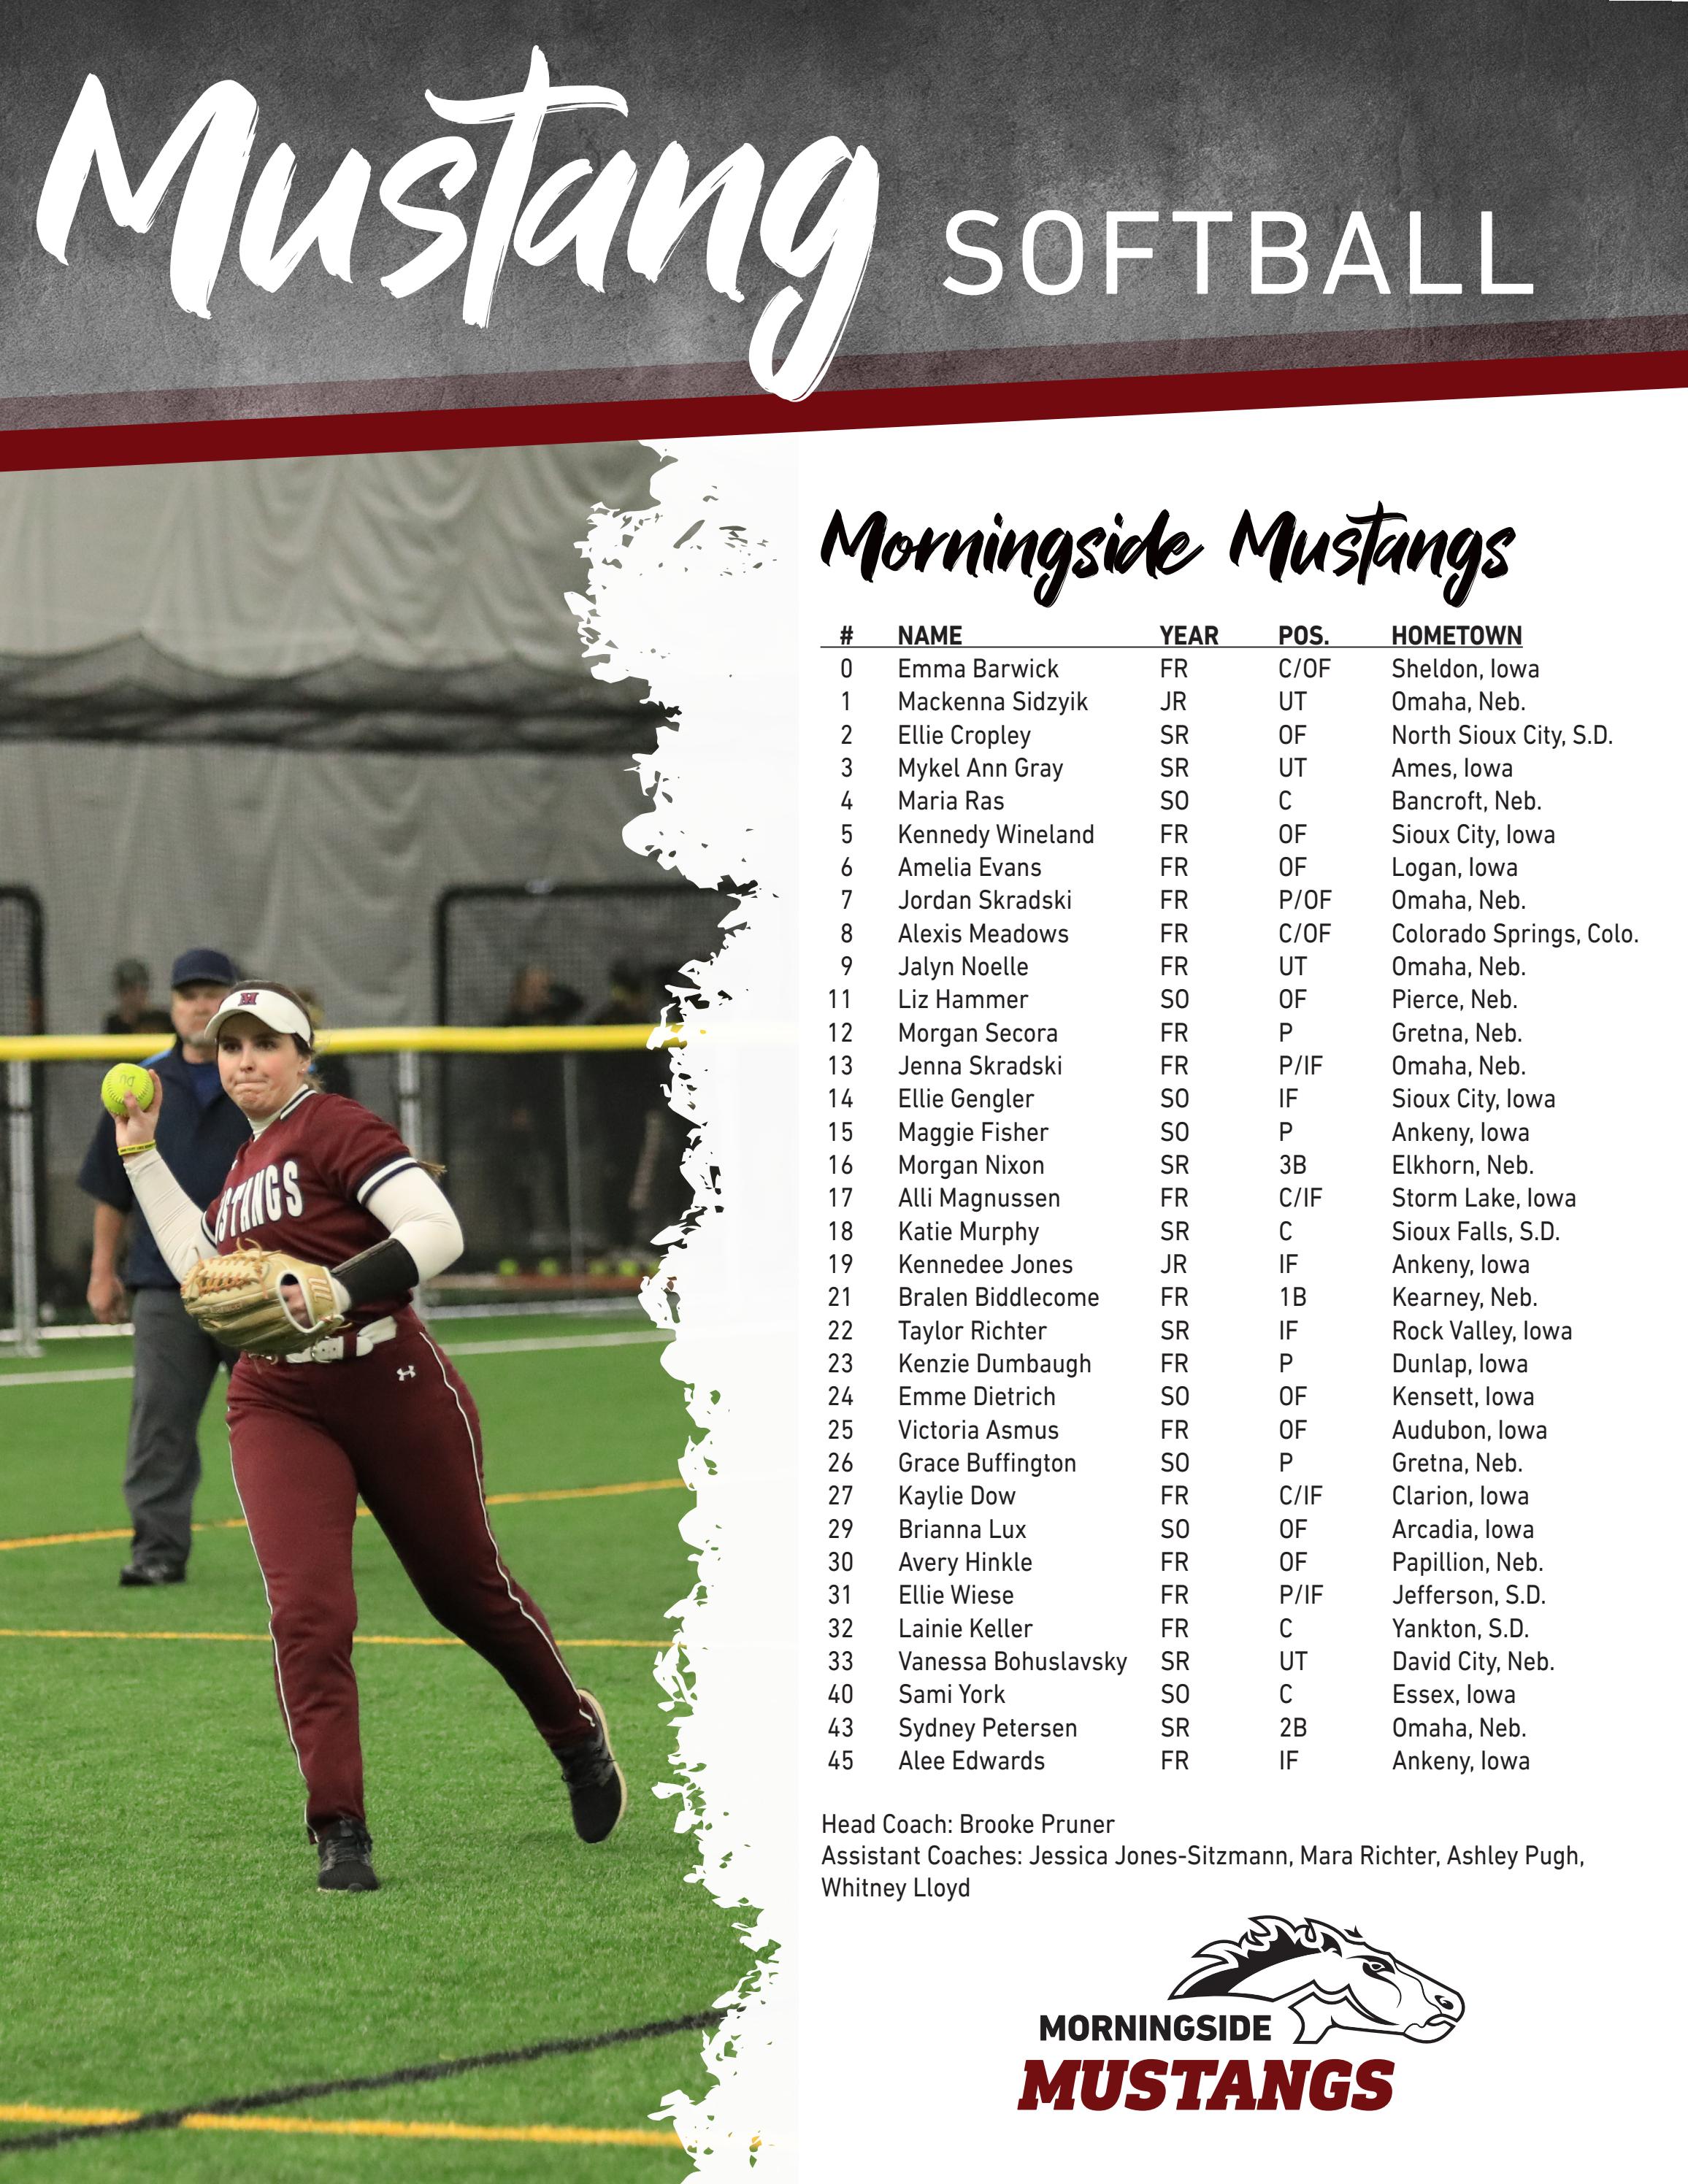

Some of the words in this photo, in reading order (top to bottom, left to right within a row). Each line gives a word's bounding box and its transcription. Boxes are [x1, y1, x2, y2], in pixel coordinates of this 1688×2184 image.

[37, 45, 879, 401] Mustang
[943, 210, 1533, 295] SOFTBALL
[821, 509, 1204, 608] Morningside
[1229, 501, 1516, 608] Mustangs
[840, 626, 853, 645] #
[899, 626, 962, 645] NAME
[1160, 626, 1219, 645] YEAR
[1280, 626, 1329, 645] POS.
[1393, 626, 1522, 645] HOMETOWN
[842, 658, 852, 678] 0
[899, 658, 964, 678] Emma
[974, 658, 1059, 678] Barwick
[1162, 658, 1187, 677] FR
[1280, 658, 1331, 678] C/OF
[1392, 658, 1483, 680] Sheldon,
[1492, 658, 1538, 678] Iowa
[843, 691, 848, 710] 1
[899, 691, 1004, 711] Mackenna
[1013, 691, 1088, 715] Sidzyik
[1160, 691, 1186, 711] JR
[1280, 691, 1307, 711] UT
[1393, 691, 1471, 713] Omaha,
[1480, 691, 1524, 711] Neb.
[842, 758, 852, 777] 3
[899, 758, 959, 782] Mykel
[967, 758, 1006, 777] Ann
[1016, 758, 1063, 782] Gray
[1161, 758, 1189, 777] SR
[1280, 758, 1307, 777] UT
[1392, 758, 1457, 780] Ames,
[1465, 758, 1512, 777] Iowa
[843, 824, 852, 844] 5
[899, 824, 989, 848] Kennedy
[997, 824, 1093, 844] Wineland
[1162, 824, 1188, 843] FR
[1280, 824, 1307, 844] OF
[1392, 824, 1449, 844] Sioux
[1458, 824, 1499, 848] City,
[1508, 824, 1554, 844] Iowa
[842, 923, 852, 943] 8
[898, 923, 962, 943] Alexis
[970, 923, 1068, 943] Meadows
[1162, 923, 1188, 942] FR
[1280, 923, 1331, 943] C/OF
[1393, 923, 1486, 943] Colorado
[1494, 923, 1580, 947] Springs,
[1589, 923, 1638, 943] Colo.
[842, 956, 852, 975] 9
[899, 956, 953, 980] Jalyn
[963, 956, 1028, 976] Noelle
[1162, 956, 1188, 975] FR
[1281, 956, 1307, 976] UT
[1393, 956, 1471, 978] Omaha,
[1480, 956, 1524, 976] Neb.
[829, 1023, 852, 1042] 12
[899, 1023, 977, 1047] Morgan
[986, 1023, 1057, 1042] Secora
[1162, 1023, 1188, 1042] FR
[1281, 1023, 1292, 1042] P
[1393, 1023, 1468, 1045] Gretna,
[1477, 1023, 1522, 1042] Neb.
[829, 1088, 853, 1107] 14
[899, 1088, 943, 1108] Ellie
[952, 1088, 1035, 1112] Gengler
[1161, 1088, 1189, 1108] SO
[1281, 1088, 1298, 1107] IF
[1393, 1088, 1450, 1108] Sioux
[1458, 1088, 1499, 1112] City,
[1508, 1088, 1554, 1108] Iowa
[829, 1188, 852, 1207] 17
[899, 1188, 931, 1207] Alli
[940, 1188, 1059, 1212] Magnussen
[1162, 1188, 1188, 1207] FR
[1280, 1188, 1322, 1207] C/IF
[1393, 1188, 1457, 1207] Storm
[1466, 1188, 1519, 1210] Lake,
[1529, 1188, 1576, 1207] Iowa
[829, 1287, 848, 1306] 21
[900, 1287, 967, 1307] Bralen
[976, 1287, 1099, 1307] Biddlecome
[1162, 1287, 1188, 1306] FR
[1281, 1287, 1306, 1306] 1B
[1394, 1287, 1483, 1311] Kearney,
[1492, 1287, 1537, 1307] Neb.
[829, 1353, 852, 1373] 23
[900, 1353, 969, 1373] Kenzie
[978, 1353, 1090, 1377] Dumbaugh
[1162, 1353, 1188, 1372] FR
[1281, 1353, 1292, 1372] P
[1394, 1353, 1471, 1377] Dunlap,
[1481, 1353, 1527, 1373] Iowa
[829, 1420, 853, 1439] 25
[899, 1420, 978, 1439] Victoria
[986, 1420, 1058, 1439] Asmus
[1162, 1420, 1188, 1439] FR
[1280, 1420, 1307, 1439] OF
[1392, 1420, 1491, 1441] Audubon,
[1500, 1420, 1546, 1439] Iowa
[829, 1485, 852, 1504] 27
[900, 1485, 962, 1510] Kaylie
[972, 1485, 1016, 1505] Dow
[1162, 1485, 1188, 1504] FR
[1281, 1485, 1322, 1505] C/IF
[1393, 1485, 1473, 1507] Clarion,
[1481, 1485, 1528, 1505] Iowa
[829, 1552, 853, 1572] 30
[899, 1552, 958, 1576] Avery
[967, 1552, 1032, 1572] Hinkle
[1162, 1552, 1188, 1571] FR
[1281, 1552, 1307, 1572] OF
[1394, 1552, 1489, 1576] Papillion,
[1497, 1552, 1542, 1572] Neb.
[829, 1651, 853, 1671] 33
[899, 1651, 986, 1671] Vanessa
[995, 1651, 1127, 1675] Bohuslavsky
[1162, 1651, 1189, 1671] SR
[1281, 1651, 1308, 1671] UT
[1394, 1651, 1450, 1671] David
[1459, 1651, 1500, 1675] City,
[1509, 1651, 1554, 1671] Neb.
[829, 1684, 853, 1704] 40
[899, 1684, 951, 1704] Sami
[959, 1684, 1005, 1704] York
[1162, 1684, 1189, 1704] SO
[1281, 1684, 1292, 1704] C
[1394, 1684, 1459, 1706] Essex,
[1468, 1684, 1515, 1704] Iowa
[829, 1750, 853, 1770] 45
[899, 1750, 944, 1770] Alee
[954, 1750, 1044, 1770] Edwards
[1162, 1750, 1189, 1769] FR
[1281, 1750, 1298, 1769] IF
[1392, 1750, 1473, 1774] Ankeny,
[1482, 1750, 1529, 1770] Iowa
[823, 1814, 875, 1833] Head
[883, 1814, 951, 1833] Coach:
[961, 1814, 1033, 1833] Brooke
[1043, 1814, 1115, 1833] Pruner
[821, 1845, 920, 1865] Assistant
[929, 1845, 1021, 1865] Coaches:
[1029, 1845, 1107, 1865] Jessica
[1115, 1845, 1292, 1867] Jones-Sitzmann,
[1302, 1845, 1352, 1865] Mara
[1362, 1845, 1440, 1867] Richter,
[1447, 1845, 1518, 1869] Ashley
[1527, 1845, 1584, 1869] Pugh,
[822, 1877, 906, 1902] Whitney
[915, 1877, 969, 1902] Lloyd
[1040, 2015, 1271, 2041] MORNINGSIDE
[1018, 2059, 1394, 2111] MUSTANGS
